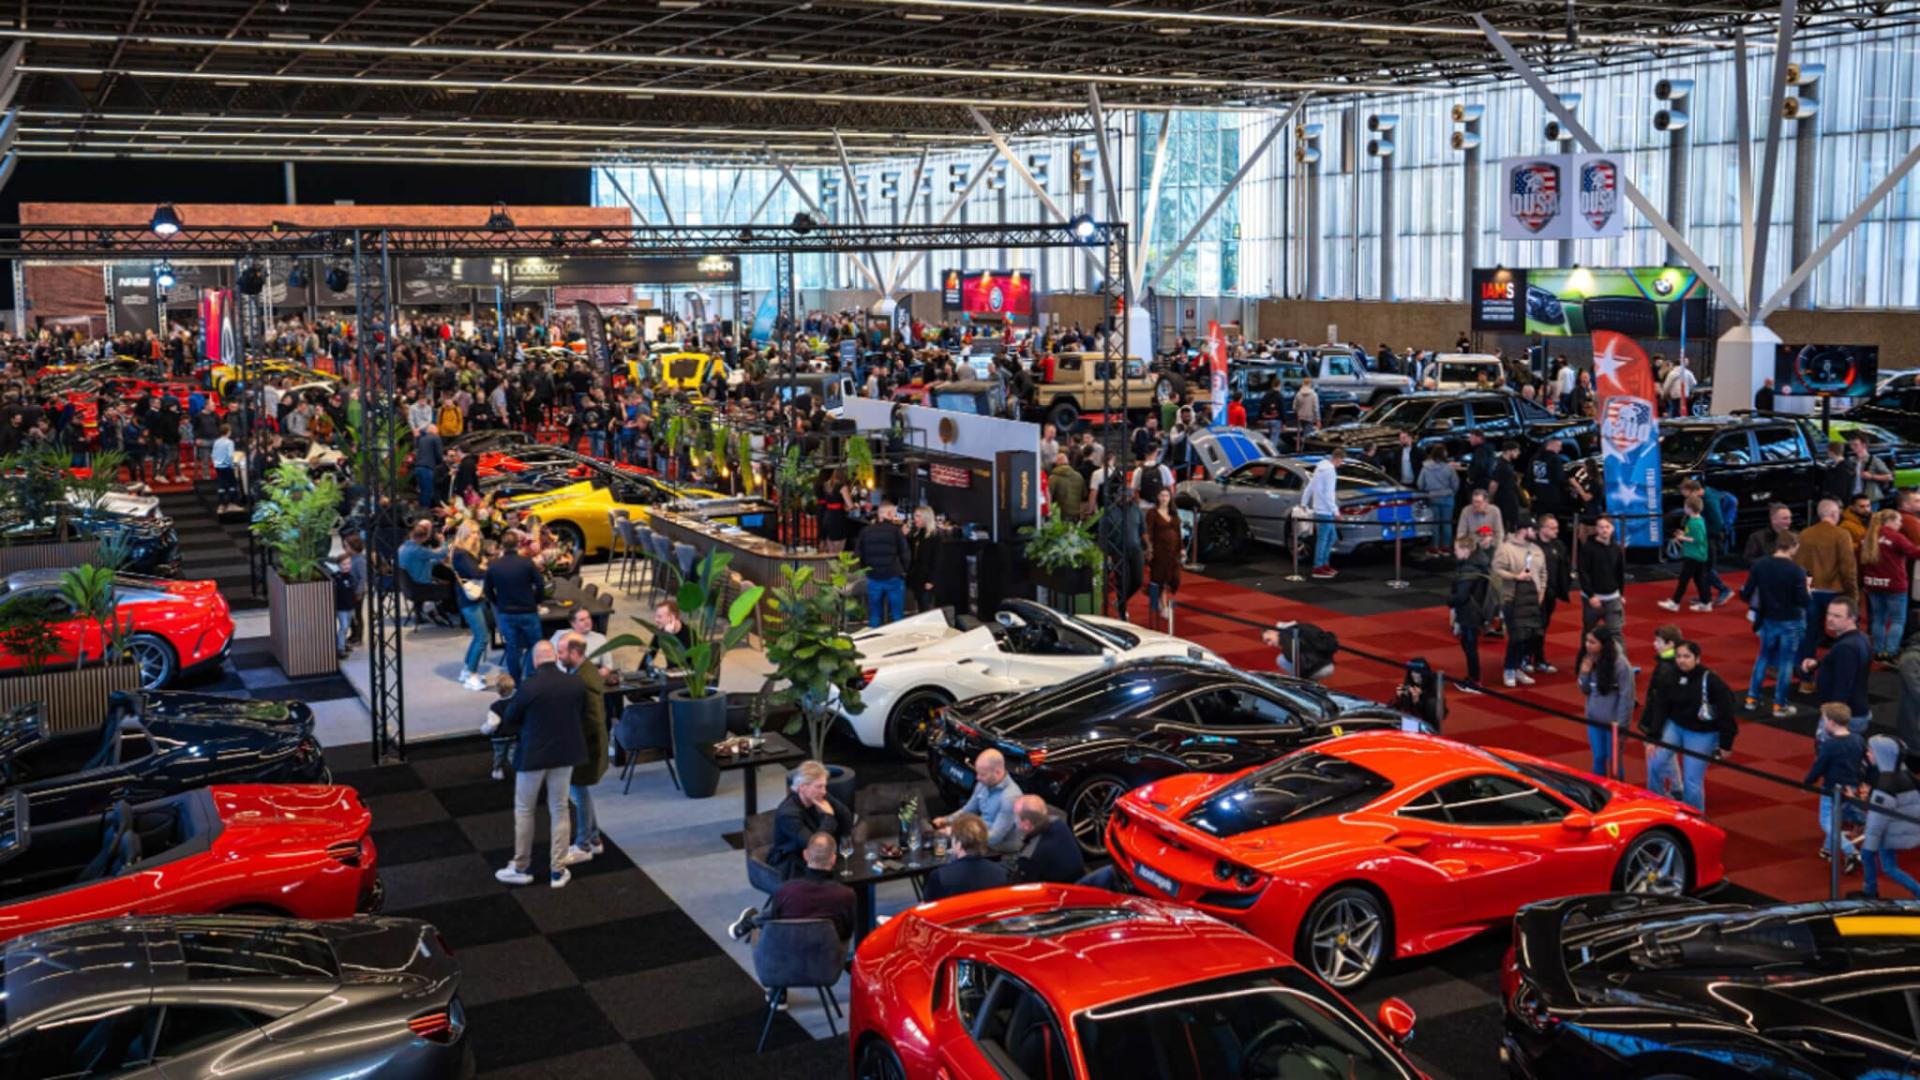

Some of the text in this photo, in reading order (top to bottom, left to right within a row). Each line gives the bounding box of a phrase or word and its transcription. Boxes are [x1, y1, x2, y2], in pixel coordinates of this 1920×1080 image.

[1511, 192, 1560, 216] DUSA
[1581, 191, 1616, 215] DUSA
[1481, 281, 1515, 299] IAMS
